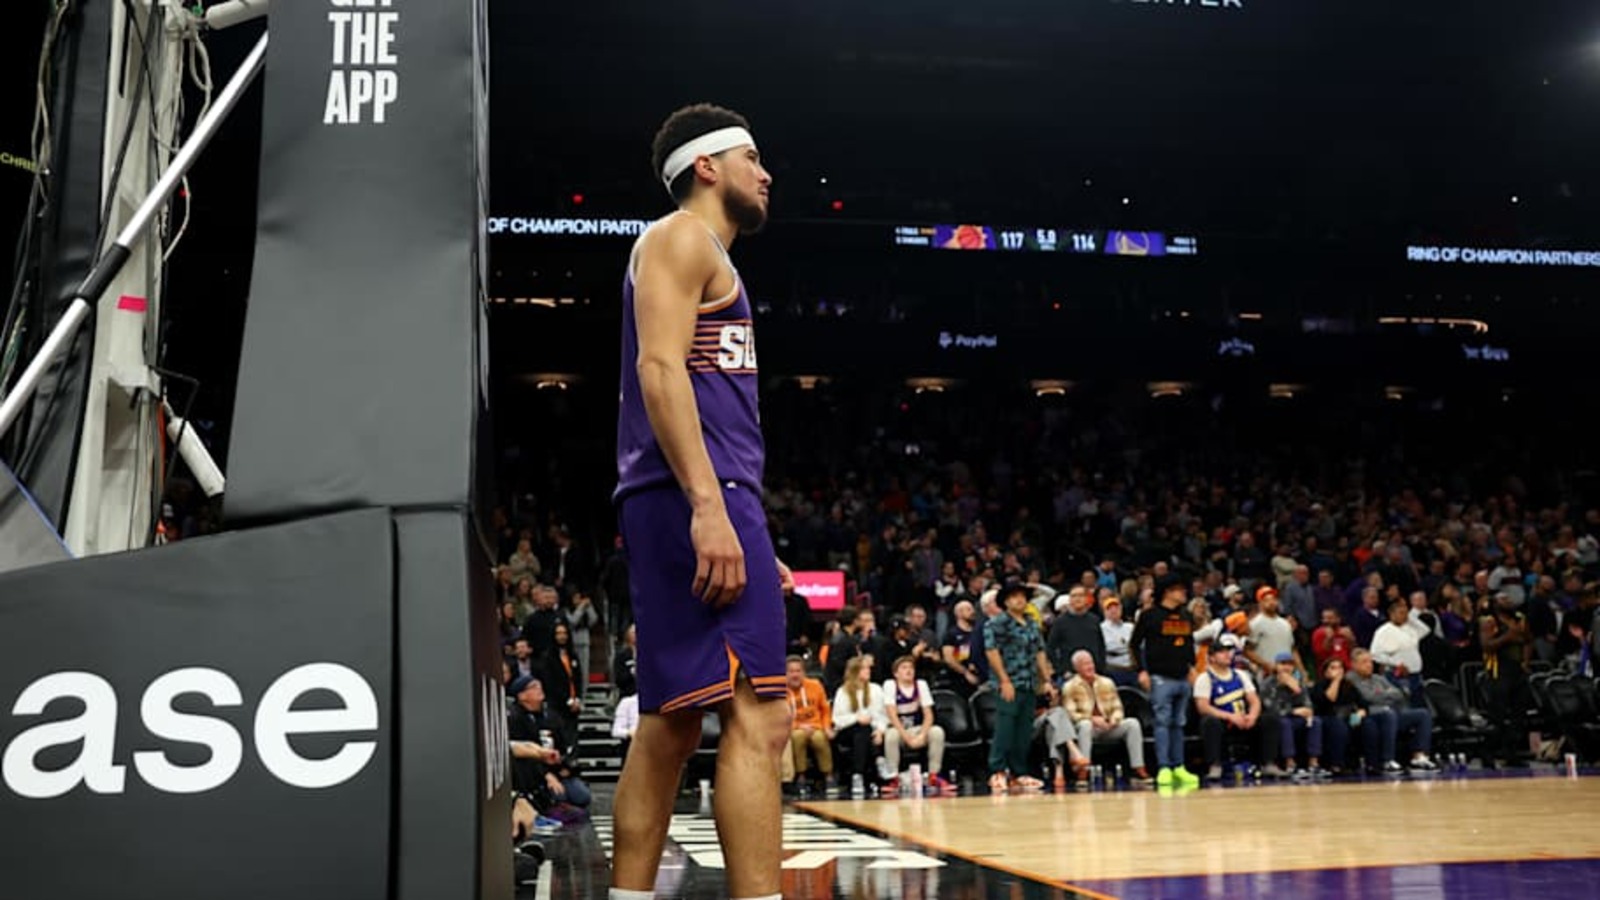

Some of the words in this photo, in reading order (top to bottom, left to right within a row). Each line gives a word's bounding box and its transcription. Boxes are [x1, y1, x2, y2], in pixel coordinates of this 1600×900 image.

[328, 11, 399, 64] THE
[323, 70, 398, 124] APP
[510, 218, 599, 235] CHAMPION
[600, 220, 654, 236] PARTN
[1001, 231, 1024, 249] 117
[1407, 246, 1440, 262] RING
[1441, 247, 1460, 263] OF
[1461, 248, 1533, 264] CHAMPION
[1535, 250, 1600, 266] PARTNERS
[2, 662, 379, 798] ase
